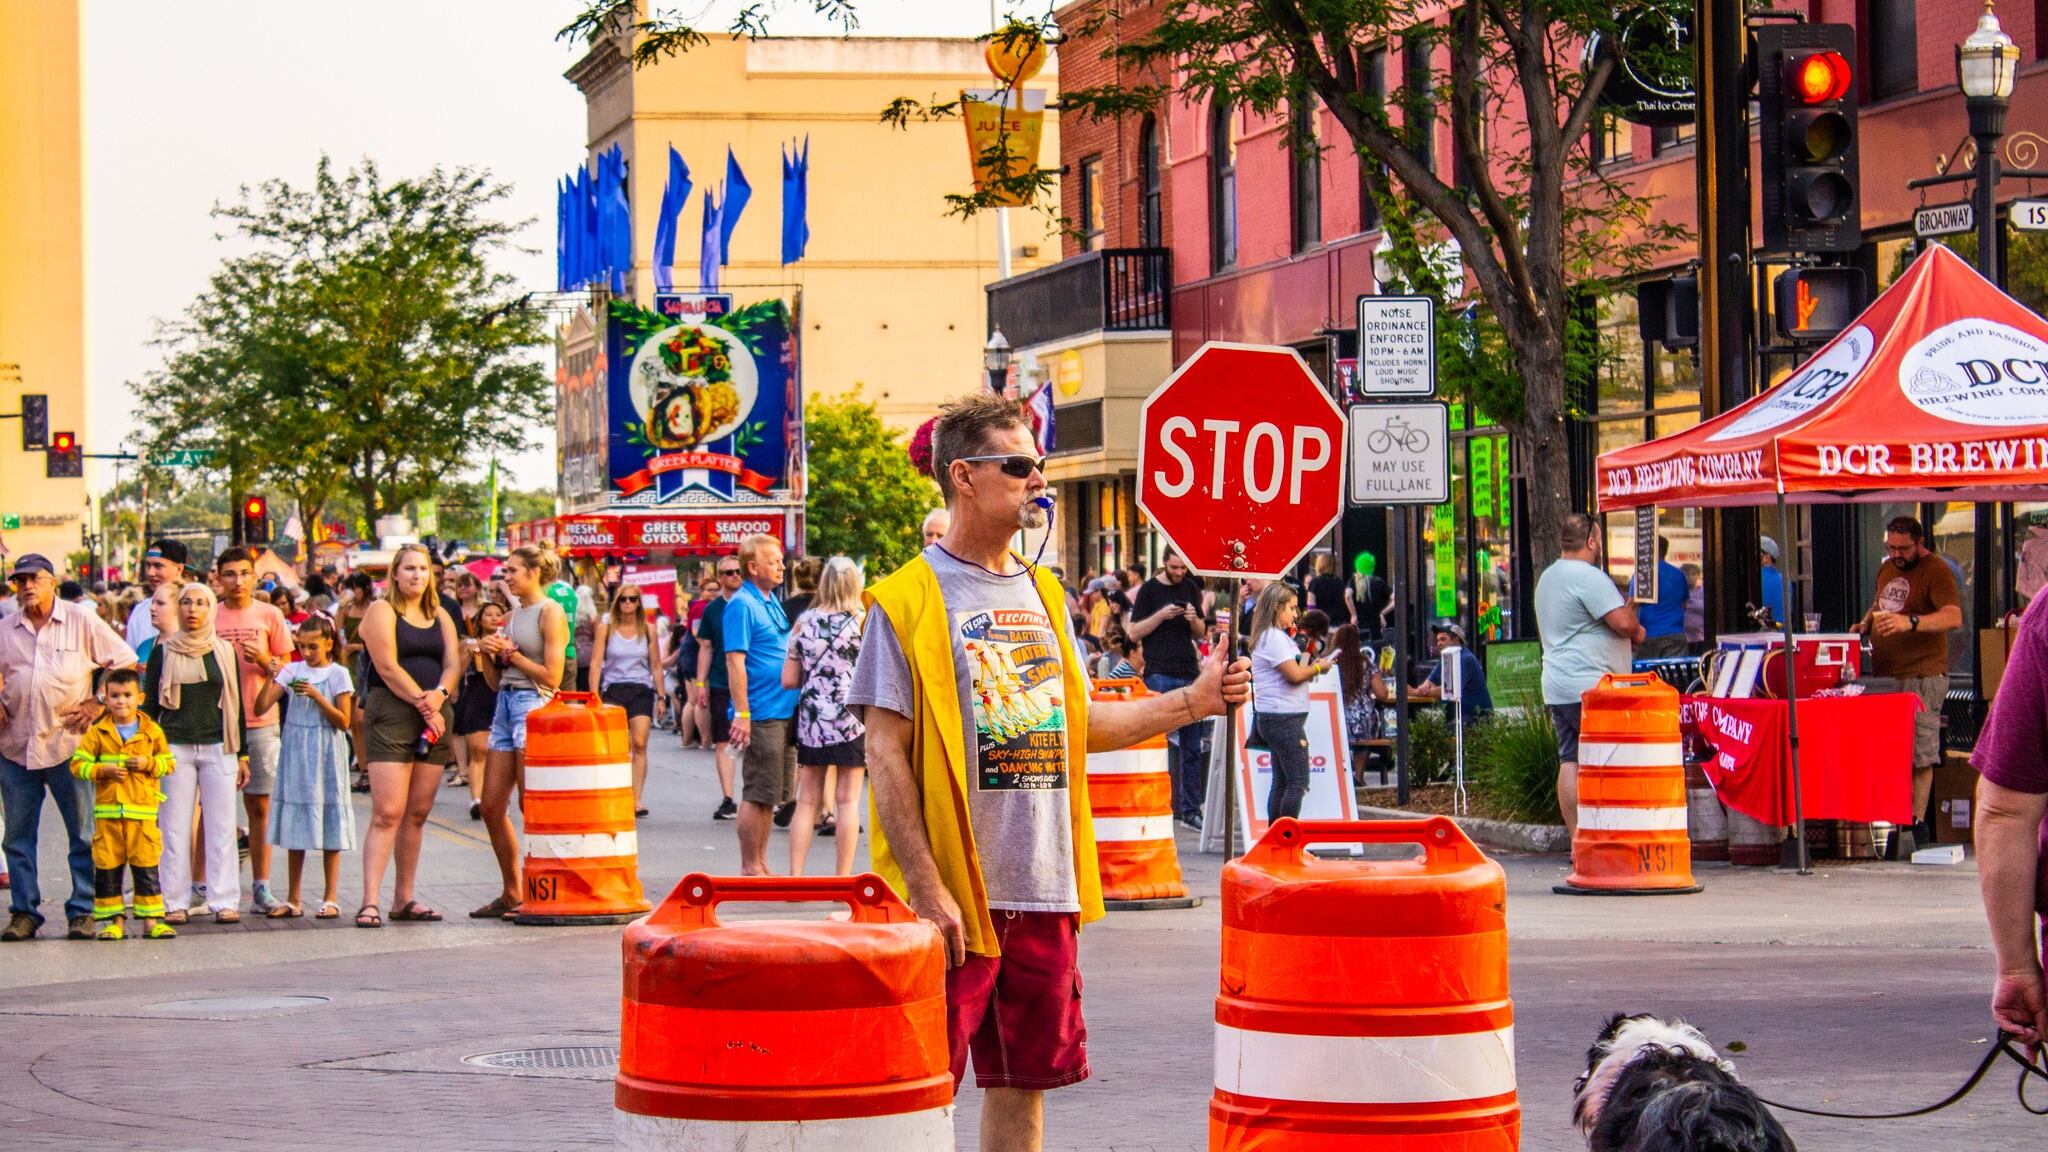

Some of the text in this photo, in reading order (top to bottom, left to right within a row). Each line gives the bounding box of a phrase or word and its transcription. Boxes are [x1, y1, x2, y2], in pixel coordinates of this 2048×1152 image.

[1636, 100, 1656, 111] Thai
[1657, 100, 1671, 111] Ice
[976, 121, 1021, 132] JUCE
[1919, 207, 1970, 231] BROADWAY
[2027, 207, 2048, 225] 1S
[1380, 309, 1412, 318] NOISE
[1367, 321, 1427, 331] ORDINANCE
[1370, 334, 1424, 343] ENFORCED
[1925, 328, 2039, 358] PRIDE AND PASSION
[1366, 359, 1428, 367] INCLUDES HORNS
[1375, 368, 1394, 376] LOUD
[1380, 377, 1415, 386] SHOUTING
[1918, 387, 2004, 405] BREWING
[1154, 415, 1331, 505] STOP
[1816, 444, 1895, 476] DCR
[1372, 460, 1425, 473] MAY USE
[1607, 449, 1763, 496] DCR BREWING COMPANY
[1366, 479, 1432, 491] FULL LANE
[566, 523, 598, 535] FRESH
[642, 521, 687, 534] GREEK
[716, 521, 771, 533] SEAFOOD
[641, 533, 689, 544] GYROS
[962, 615, 989, 634] TV STAR
[1011, 644, 1047, 666] WATER
[1029, 733, 1048, 747] KITE
[979, 742, 996, 752] PLUS
[988, 749, 1038, 760] SKY-HIGH
[999, 761, 1043, 774] DANCING
[1012, 773, 1020, 784] 2
[1638, 843, 1674, 873] NSI
[528, 877, 557, 901] NSI
